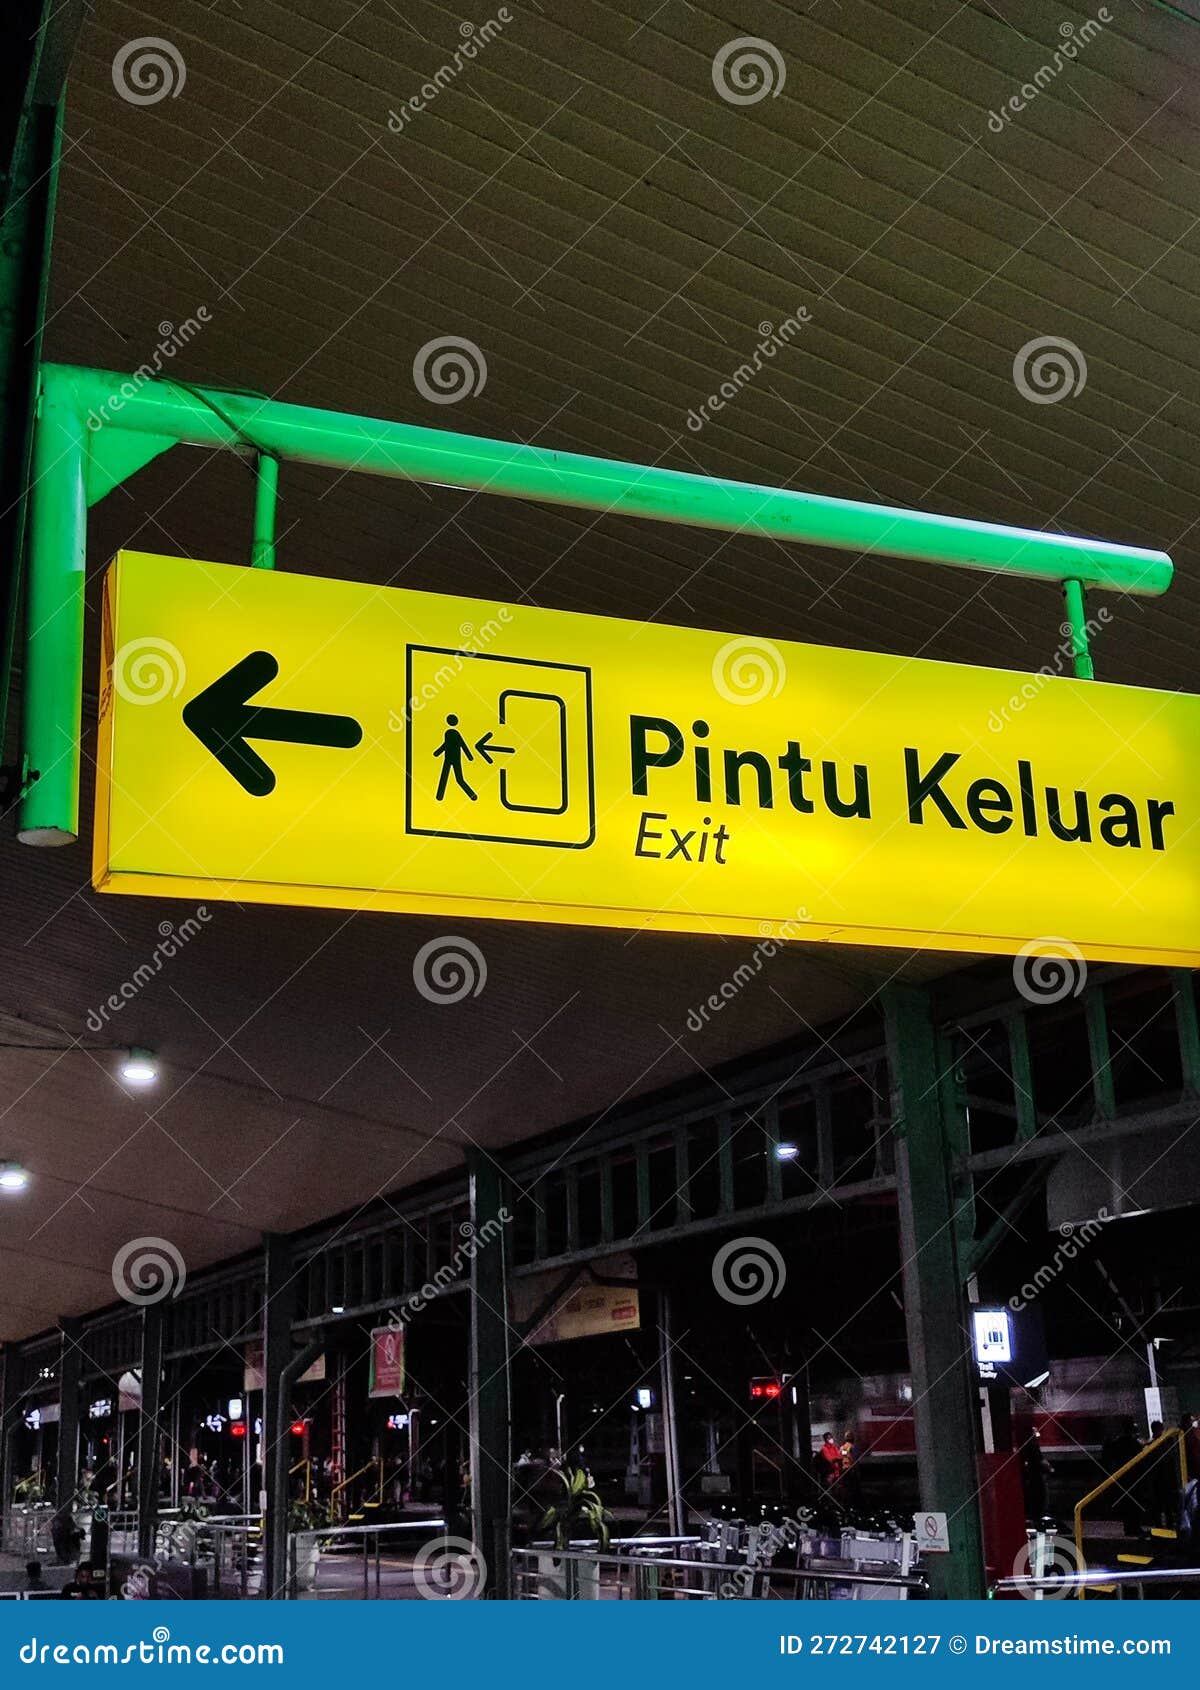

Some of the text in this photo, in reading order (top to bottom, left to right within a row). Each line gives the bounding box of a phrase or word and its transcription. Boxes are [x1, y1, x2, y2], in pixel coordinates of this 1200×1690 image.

[630, 715, 1175, 851] Pintu Keluar
[634, 812, 730, 865] Exit
